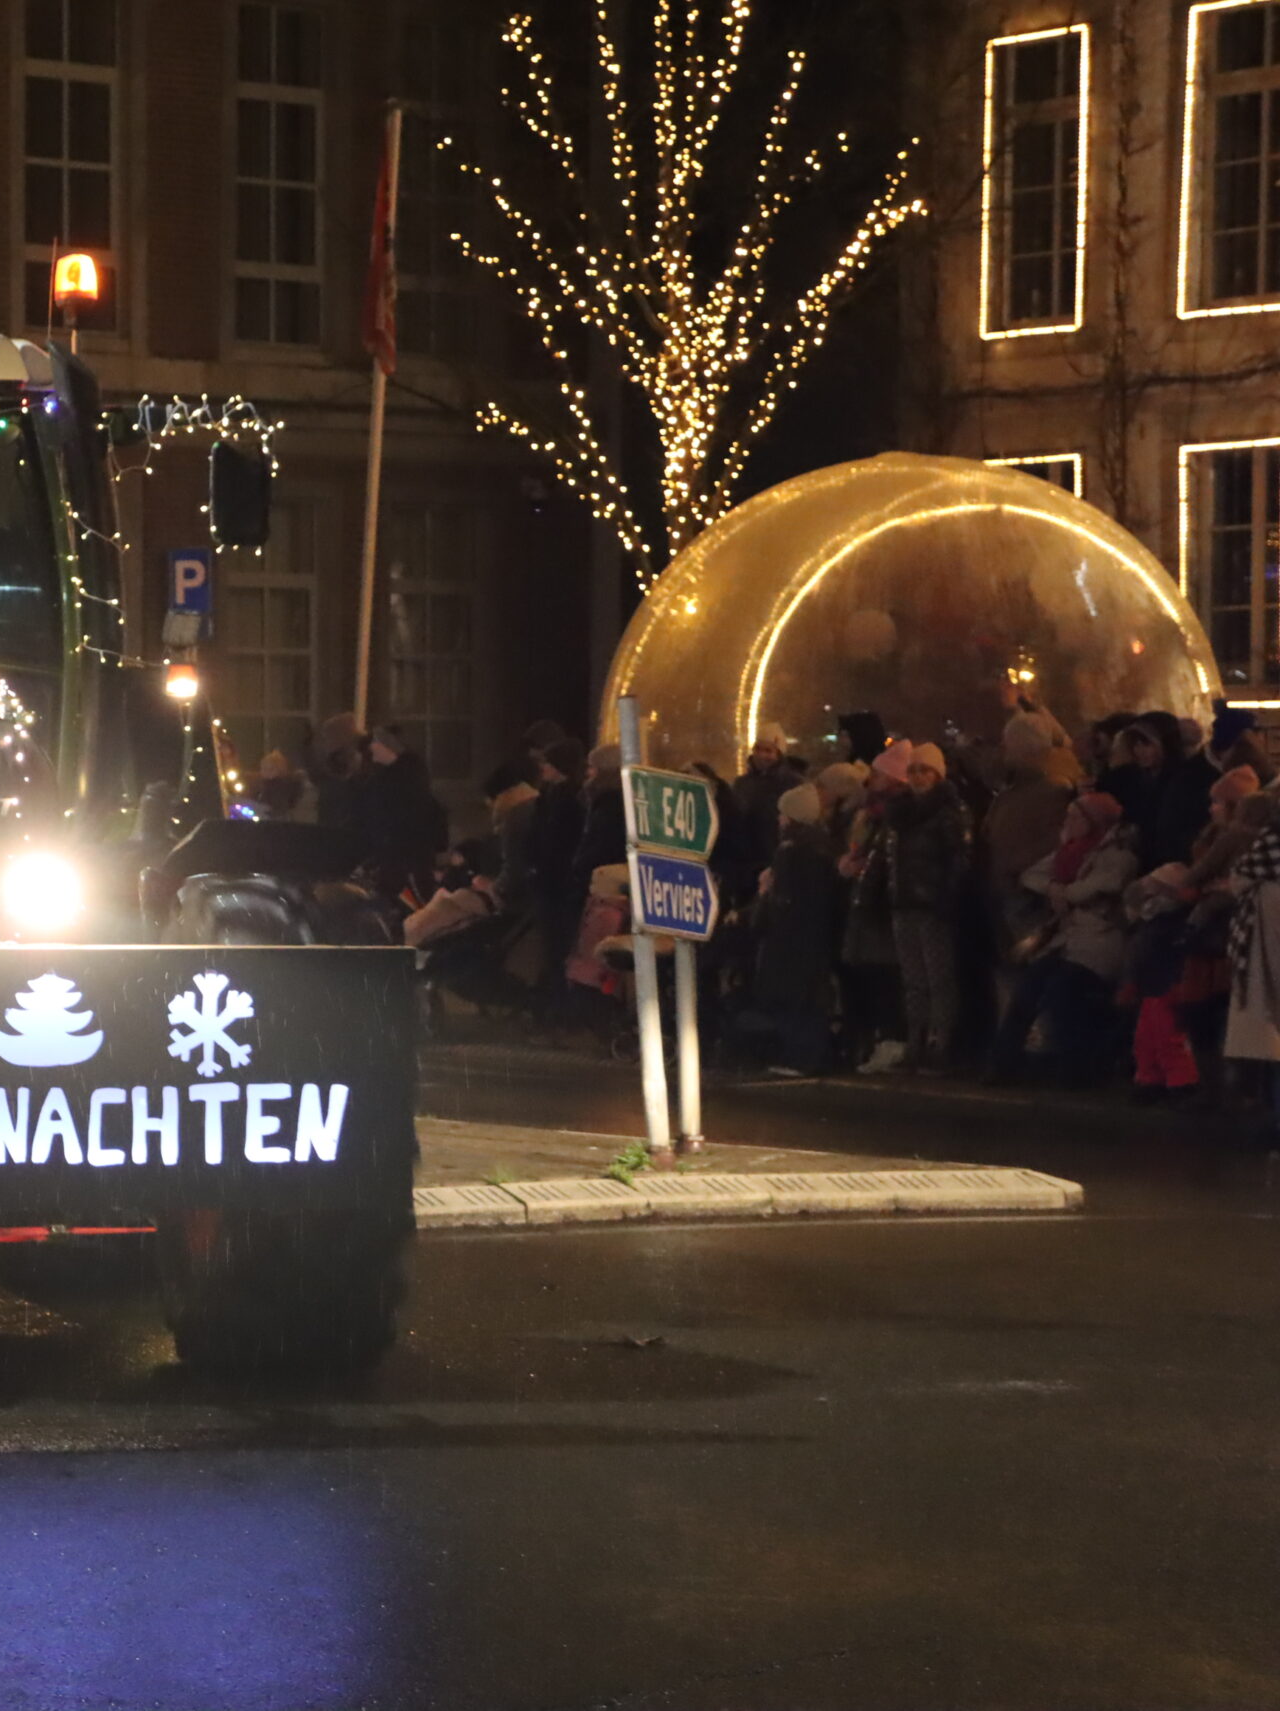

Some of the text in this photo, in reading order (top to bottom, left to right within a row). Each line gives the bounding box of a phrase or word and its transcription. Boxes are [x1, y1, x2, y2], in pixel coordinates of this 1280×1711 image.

[175, 560, 205, 604] P
[662, 786, 695, 841] E40
[640, 864, 705, 925] Verviers
